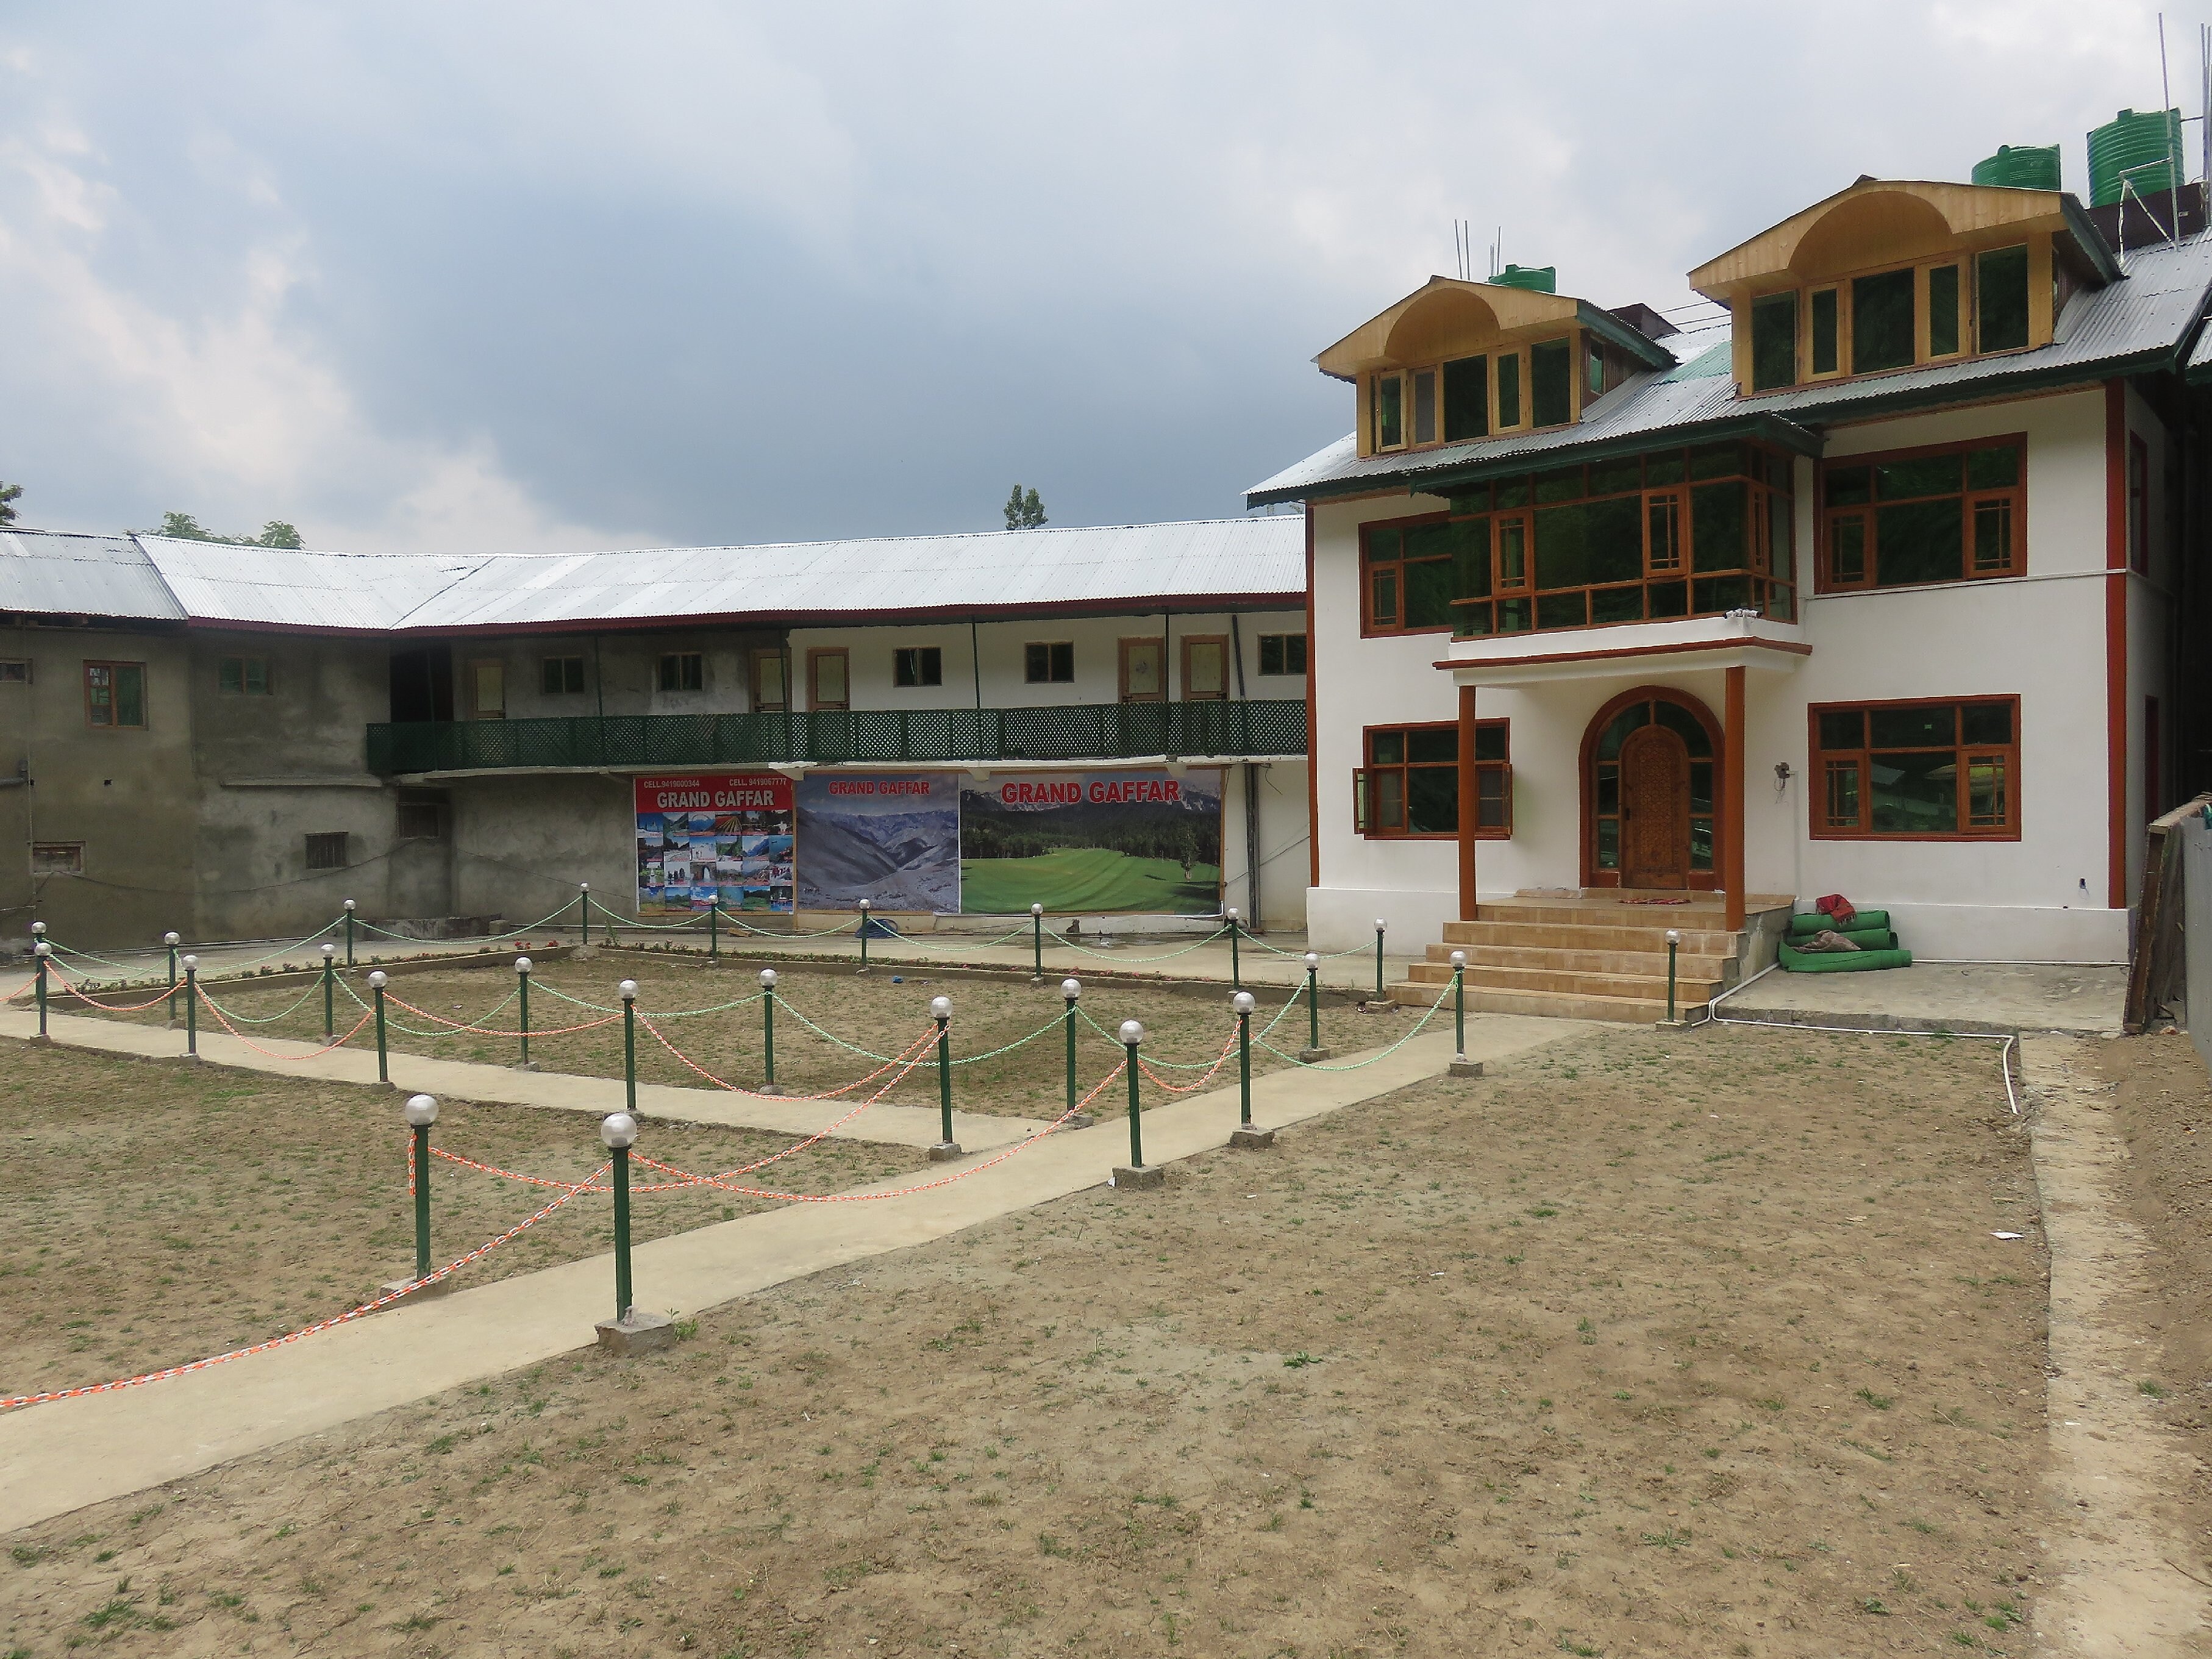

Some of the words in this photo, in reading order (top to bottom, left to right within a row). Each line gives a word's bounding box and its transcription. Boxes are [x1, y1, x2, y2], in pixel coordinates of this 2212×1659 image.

[829, 780, 876, 795] GRAND
[878, 780, 930, 795] GAFFAR
[1001, 782, 1082, 804] GRAND
[1088, 780, 1181, 804] GAFFAR
[657, 791, 710, 808] GRAND
[715, 790, 775, 807] GAFFAR
